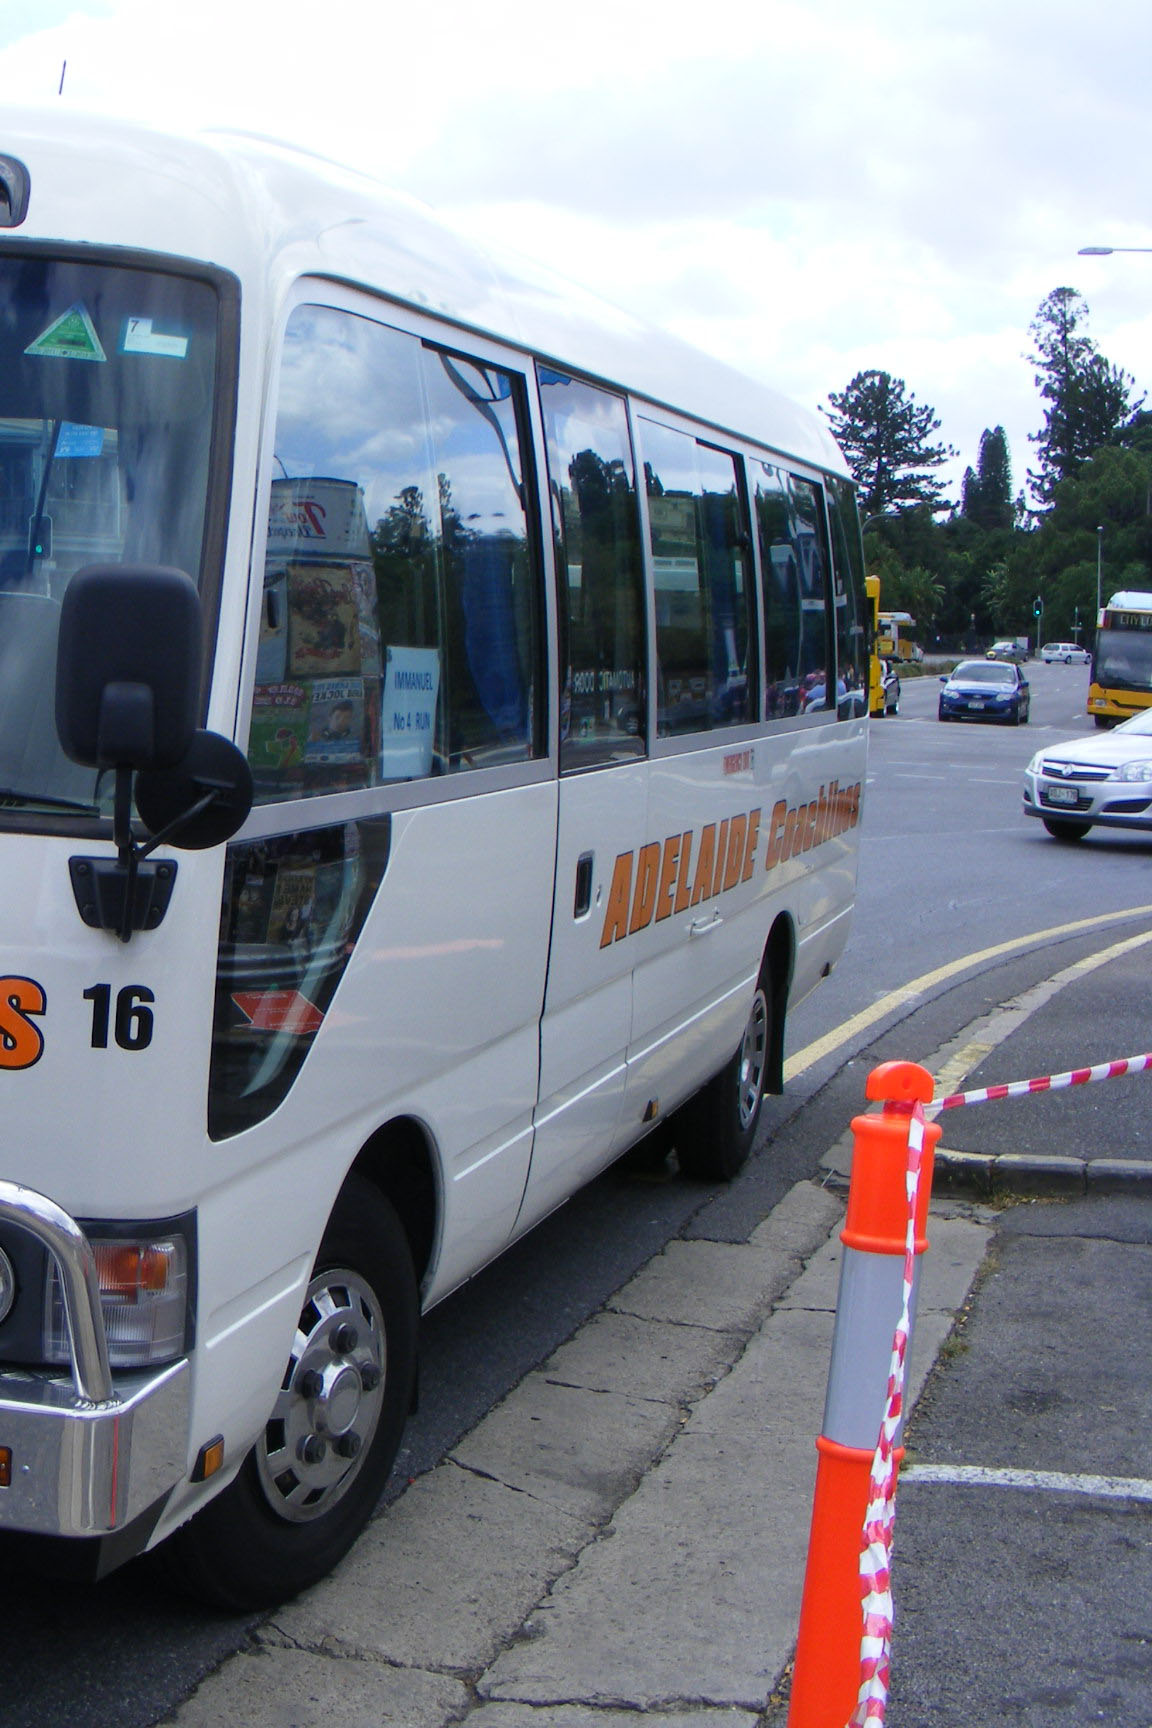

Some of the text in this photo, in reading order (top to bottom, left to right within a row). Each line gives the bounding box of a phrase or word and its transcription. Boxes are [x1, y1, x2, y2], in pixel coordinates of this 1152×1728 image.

[130, 319, 140, 333] 7
[394, 671, 434, 691] IMMANUEL
[393, 712, 431, 730] No 4 RUN
[599, 780, 862, 950] ADELAIDE Coachlines
[82, 982, 156, 1051] 16
